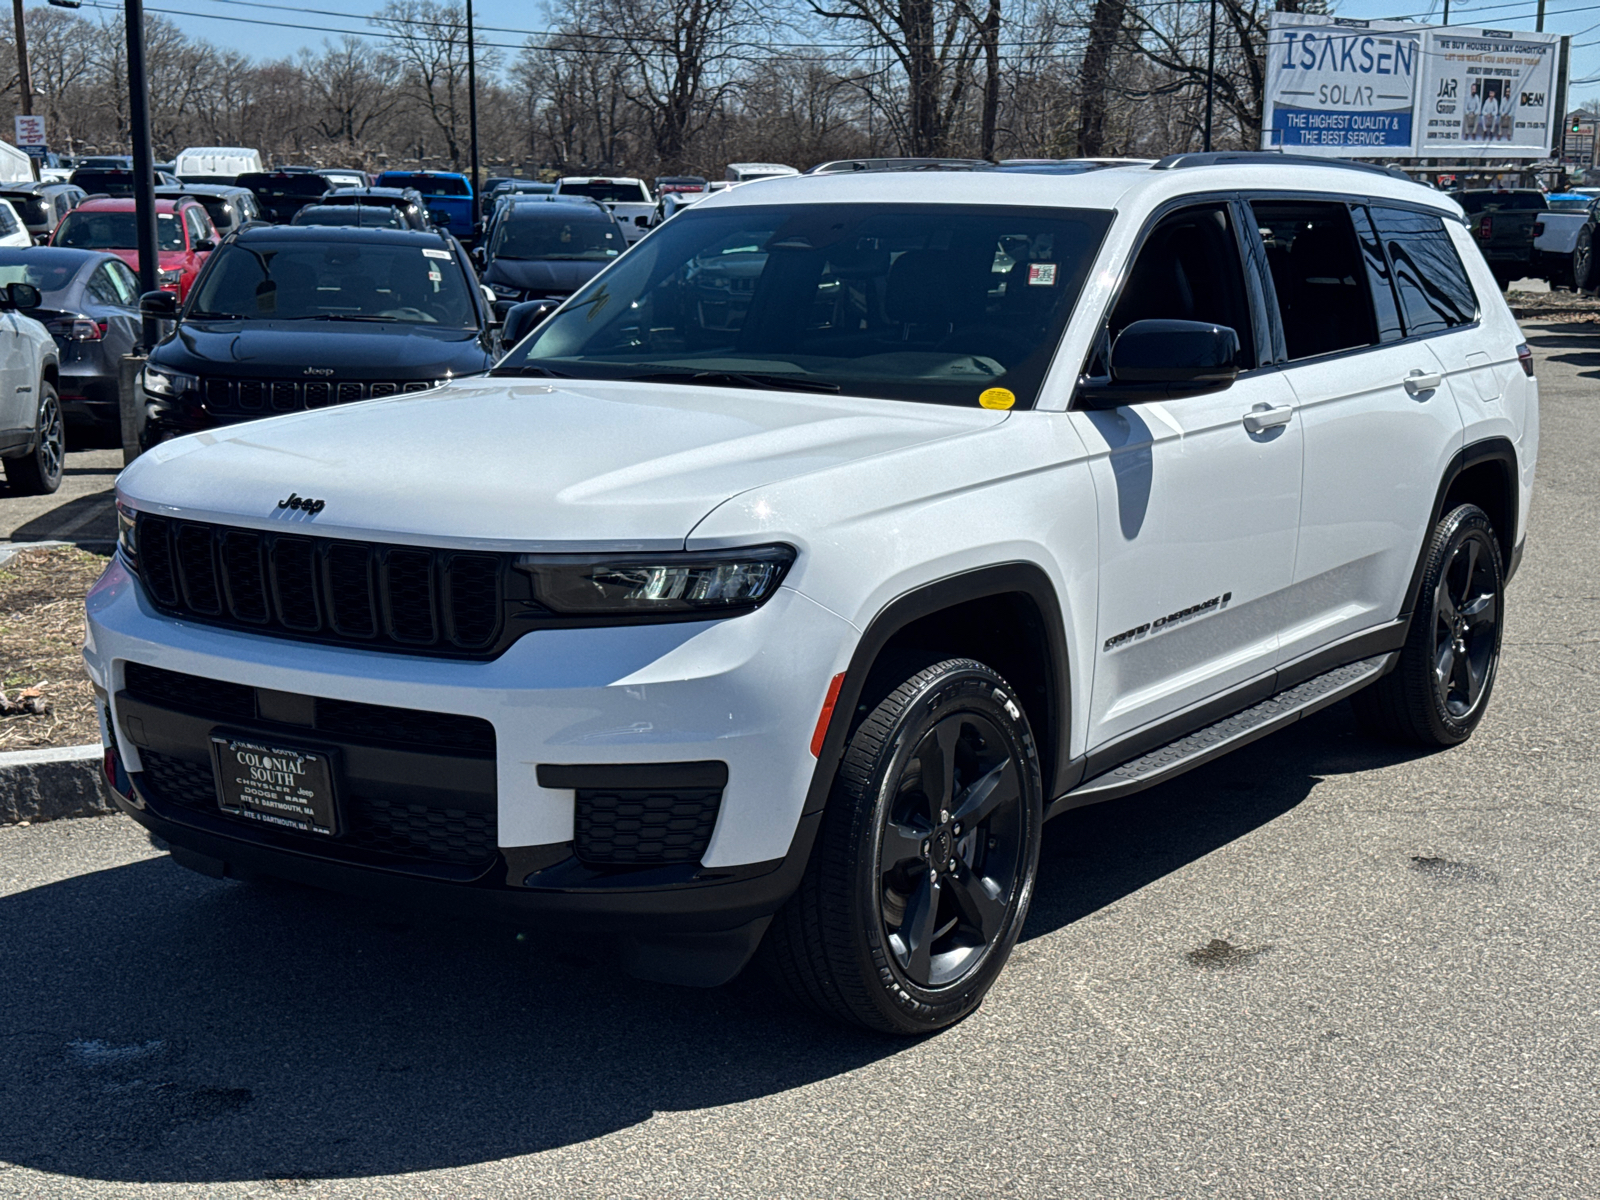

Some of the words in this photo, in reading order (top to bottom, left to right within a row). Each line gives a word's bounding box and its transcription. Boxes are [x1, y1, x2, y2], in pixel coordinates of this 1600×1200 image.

[1281, 32, 1413, 76] ISAKSEN
[1440, 40, 1450, 49] WE
[1451, 41, 1465, 50] BUY
[1466, 42, 1491, 51] HOUSES
[1492, 43, 1499, 52] IN
[1500, 44, 1513, 52] ANY
[1514, 45, 1547, 55] CONDITION
[1505, 57, 1522, 65] OFFER
[1318, 84, 1374, 106] SOLAR
[1437, 78, 1458, 98] JAR
[1436, 99, 1456, 114] GROUP
[1521, 92, 1545, 107] DEAN
[1287, 113, 1308, 128] THE
[1308, 114, 1349, 129] HIGHEST
[1352, 115, 1390, 130] QUALITY
[1392, 117, 1399, 130] &
[1300, 131, 1318, 144] THE
[1321, 131, 1345, 145] BEST
[1347, 131, 1386, 145] SERVICE
[303, 366, 334, 377] Jeep
[278, 492, 326, 515] Jeep
[271, 748, 299, 758] SOUTH
[237, 751, 306, 775] COLONIAL
[250, 766, 295, 787] SOUTH
[236, 777, 291, 793] CHRYSLER
[297, 787, 315, 799] Jeep
[244, 786, 278, 799] DODGE
[284, 795, 308, 804] RAM
[240, 794, 254, 803] RTE.
[261, 799, 303, 814] DARTMOUTH,
[304, 807, 315, 815] MA
[262, 815, 298, 830] DARTMOUTH,
